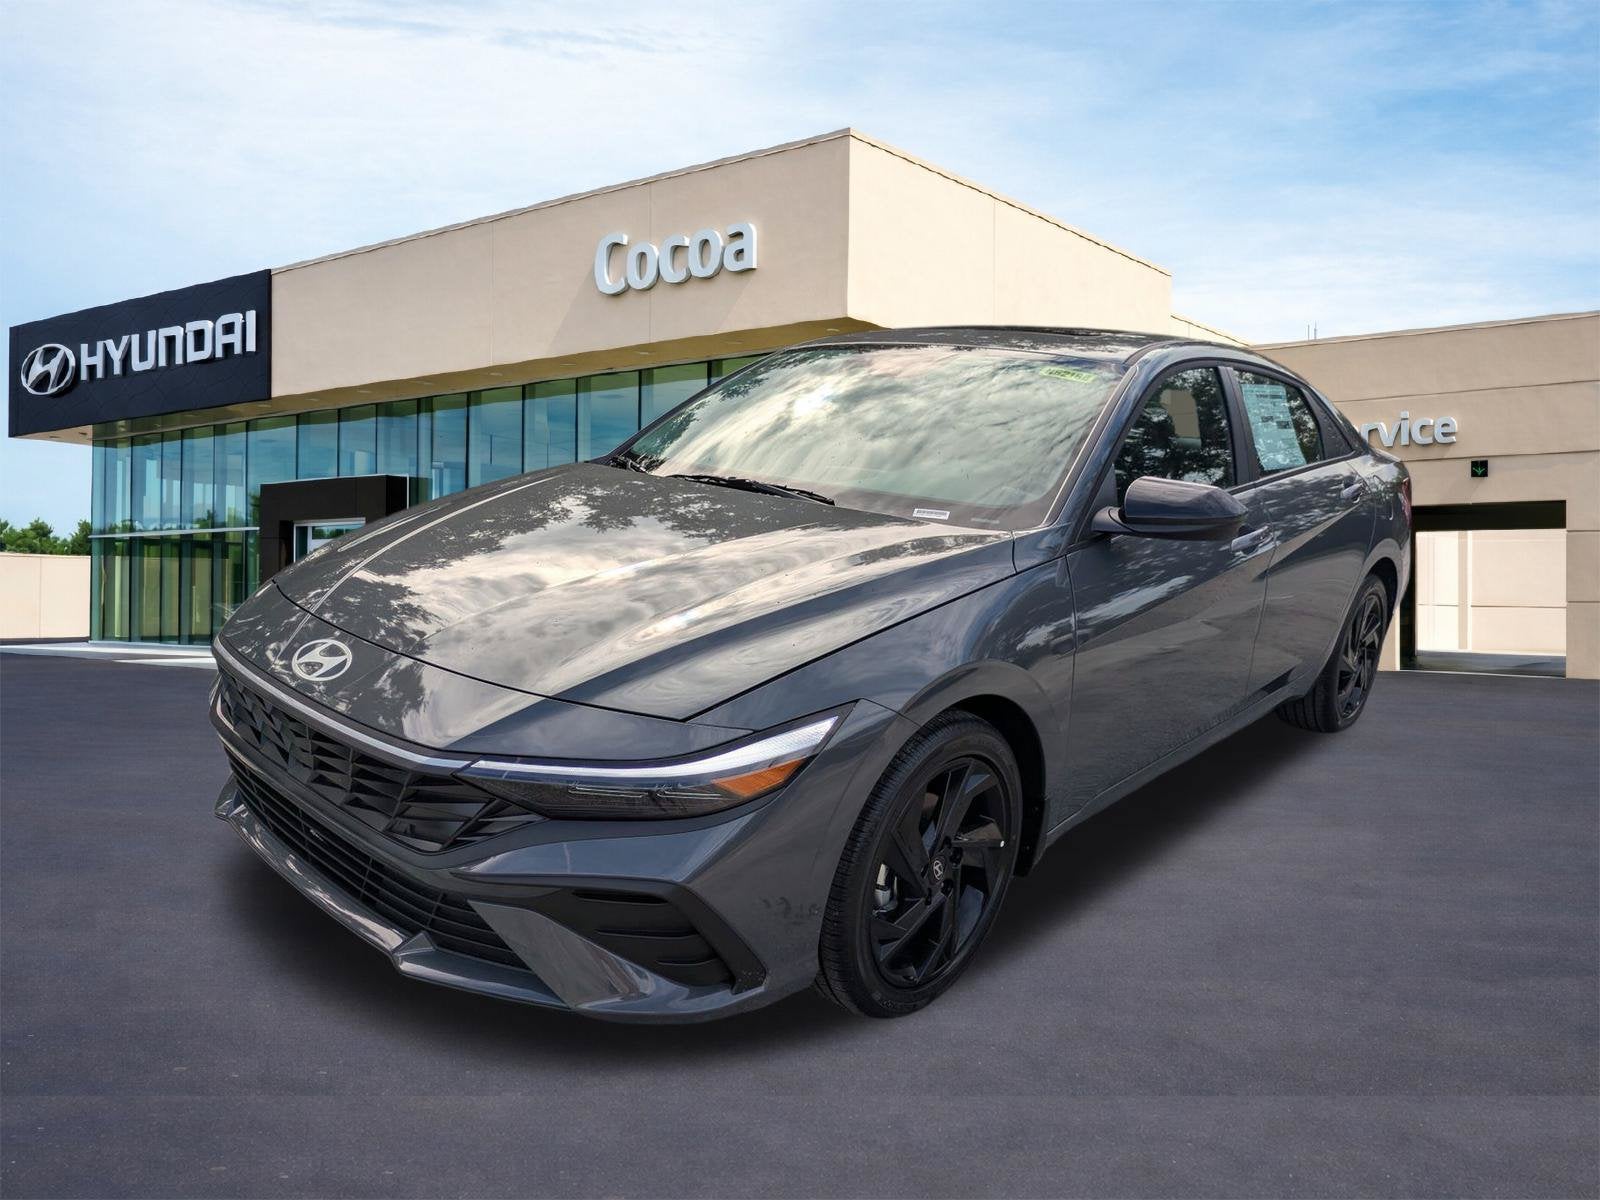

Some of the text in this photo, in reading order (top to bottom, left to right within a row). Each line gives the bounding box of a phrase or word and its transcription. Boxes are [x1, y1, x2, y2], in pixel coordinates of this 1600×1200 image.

[594, 222, 758, 295] Cocoa
[80, 309, 256, 381] HYUNDAI
[1354, 411, 1457, 447] rvice
